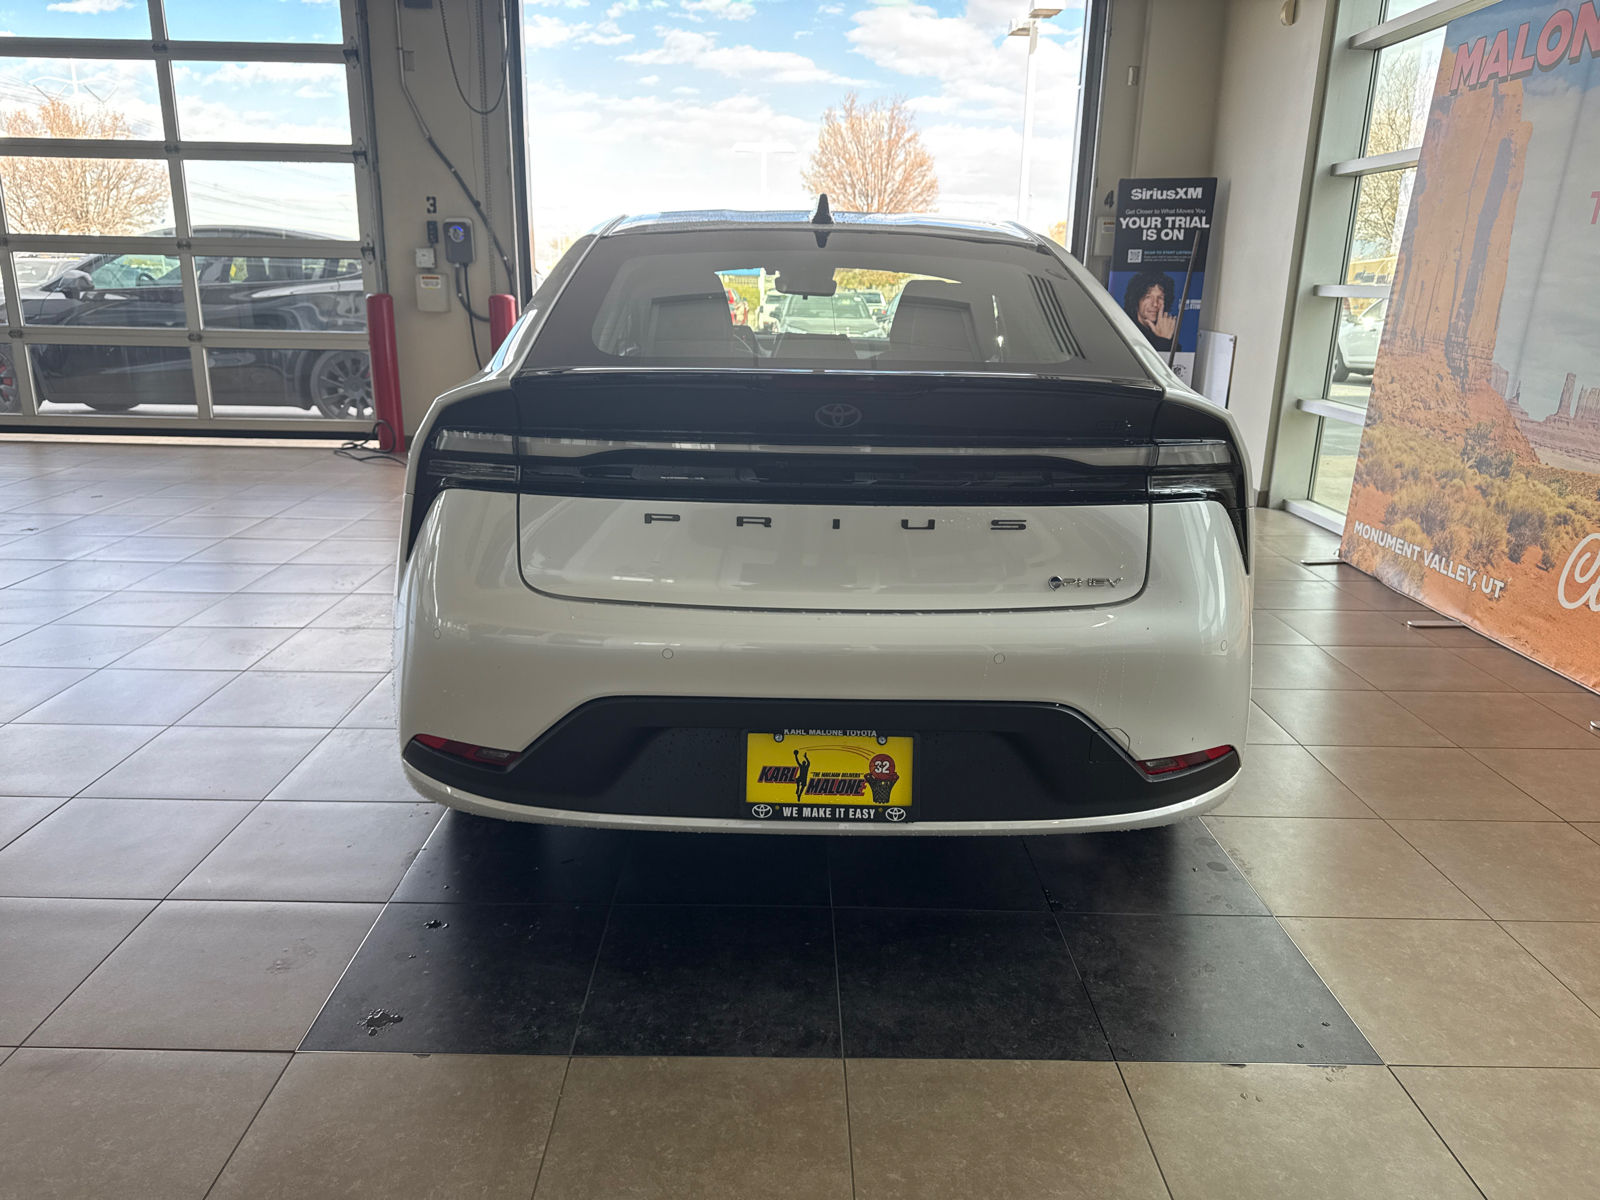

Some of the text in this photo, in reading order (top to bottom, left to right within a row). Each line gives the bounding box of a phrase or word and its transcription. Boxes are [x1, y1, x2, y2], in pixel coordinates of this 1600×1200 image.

[1104, 190, 1114, 209] 4
[1131, 187, 1203, 200] SiriusXM
[426, 196, 437, 214] 3
[1119, 216, 1210, 229] YOUR TRIAL
[1142, 228, 1184, 240] IS ON
[644, 512, 1028, 531] PRIUS
[1354, 520, 1505, 598] MONUMENT VALLEY, UT
[1062, 578, 1123, 588] PHEV
[874, 761, 890, 773] 32
[758, 766, 799, 784] KARL
[805, 778, 867, 796] MALONE
[782, 806, 876, 819] WE MAKE IT EASY
